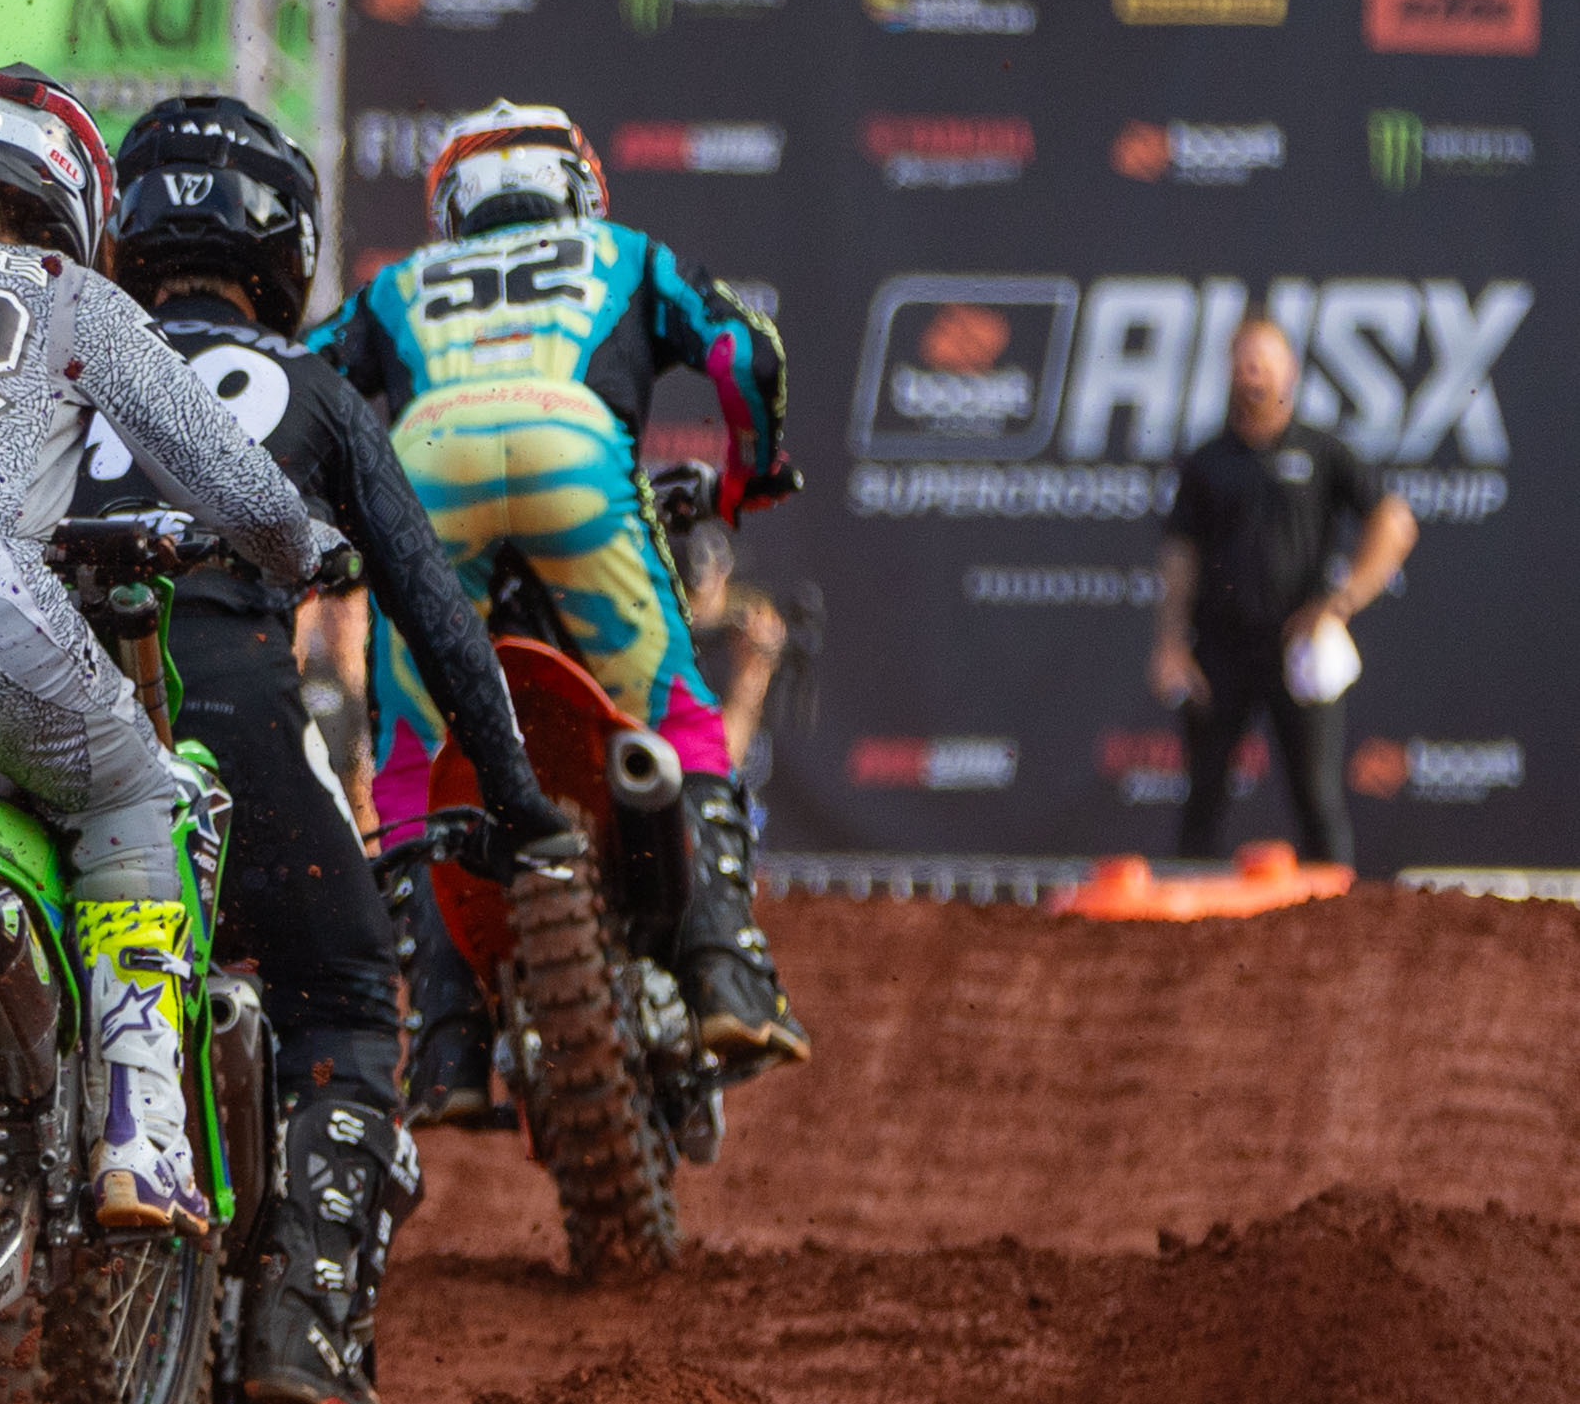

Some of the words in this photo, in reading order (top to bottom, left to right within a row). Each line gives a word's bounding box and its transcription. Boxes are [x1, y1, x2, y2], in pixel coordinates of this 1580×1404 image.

[48, 148, 79, 181] BELL
[420, 236, 595, 325] 52
[1064, 273, 1536, 463] AUSX
